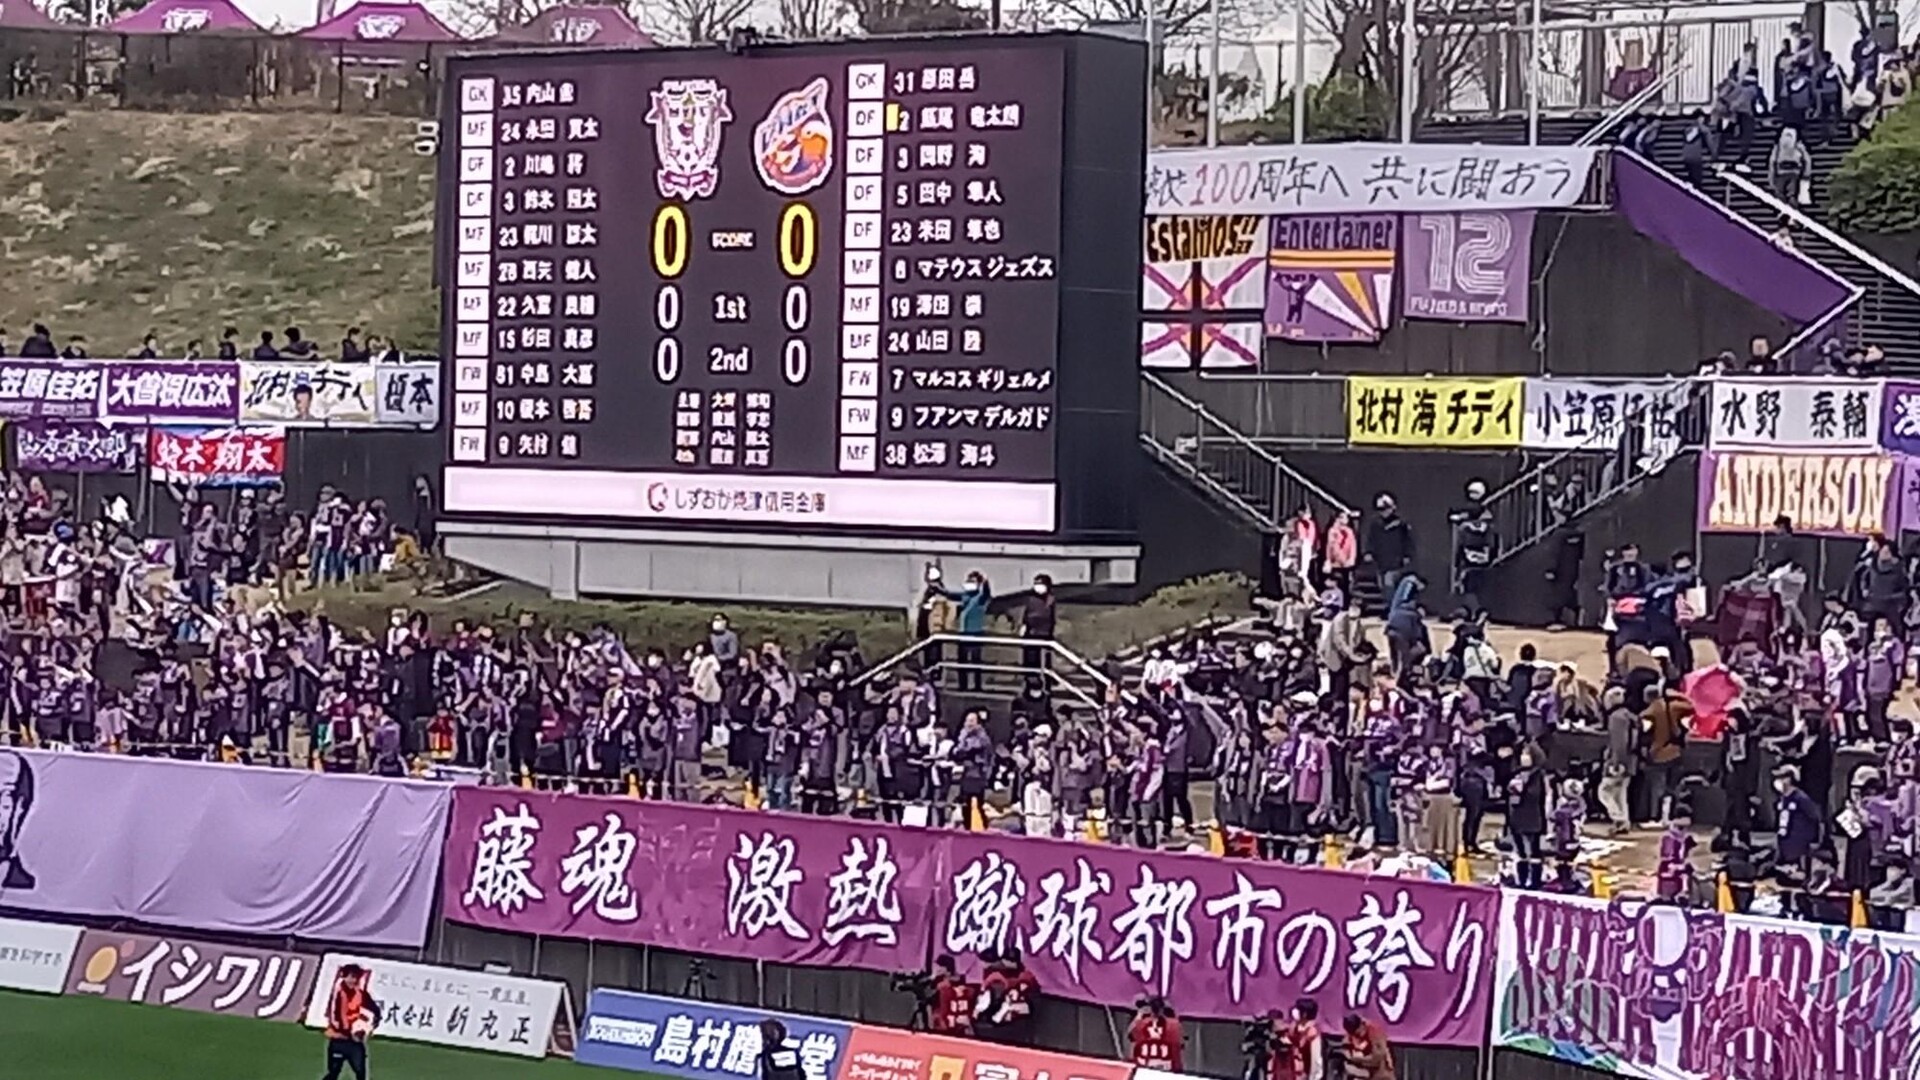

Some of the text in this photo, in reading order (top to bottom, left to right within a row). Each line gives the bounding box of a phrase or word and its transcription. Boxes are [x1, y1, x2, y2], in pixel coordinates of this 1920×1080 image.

[856, 72, 876, 88] GK
[894, 71, 914, 93] 31
[856, 110, 873, 125] DF
[501, 122, 520, 141] 24
[855, 147, 874, 163] DF
[504, 158, 516, 178] 2
[1363, 155, 1571, 206] 共に闘おう
[504, 191, 514, 212] 3
[854, 184, 874, 200] DF
[897, 186, 908, 205] 5
[919, 181, 953, 205] 田中
[499, 226, 518, 247] 23
[654, 205, 687, 276] 0
[780, 204, 814, 276] 0
[854, 221, 874, 237] DF
[891, 220, 912, 244] 23
[918, 219, 952, 242] 米田
[1420, 213, 1512, 296] 12
[852, 258, 873, 275] MF
[918, 258, 982, 280] マテウス
[498, 298, 516, 317] 22
[658, 286, 808, 330] 0 1st 0
[850, 298, 872, 312] MF
[498, 330, 516, 349] 15
[888, 331, 910, 352] 24
[915, 330, 950, 352] 山田
[656, 337, 808, 384] 0 2nd 0
[892, 369, 904, 391] 7
[912, 369, 972, 390] マルコス
[496, 400, 513, 420] 10
[892, 407, 904, 428] 9
[983, 404, 1051, 429] デルガド
[1356, 387, 1514, 437] 北村 海 チディ
[1720, 387, 1782, 439] 水野
[1709, 453, 1893, 534] ANDERSON
[463, 802, 639, 923] 藤魂
[726, 832, 903, 947] 激熱
[946, 852, 1486, 1023] 蹴球都市の誇り
[121, 938, 303, 1019] イシワリ
[376, 1000, 435, 1029] 式会社
